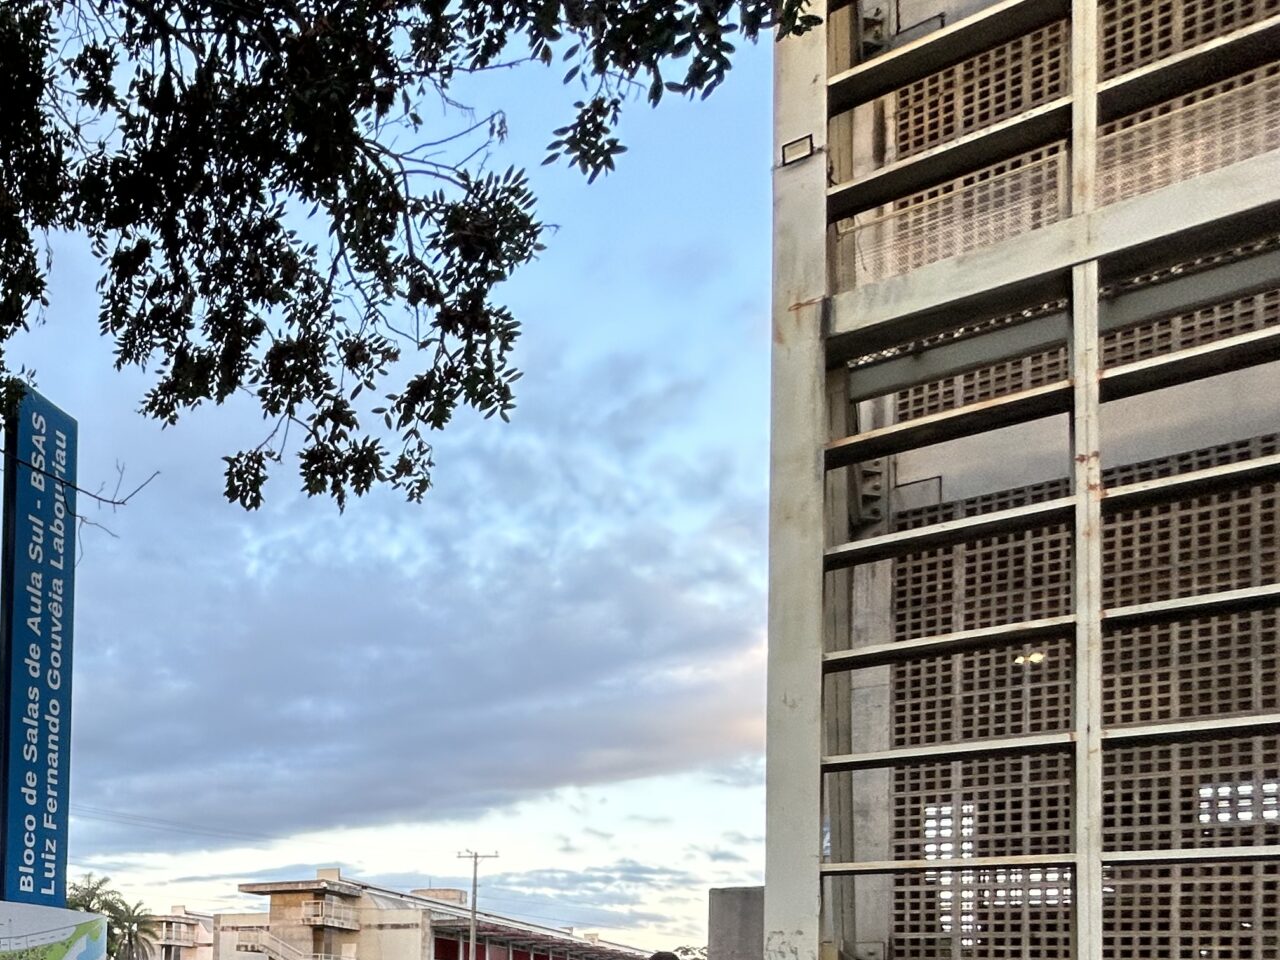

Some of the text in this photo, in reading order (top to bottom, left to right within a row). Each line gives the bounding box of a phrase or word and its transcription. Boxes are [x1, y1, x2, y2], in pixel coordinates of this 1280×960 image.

[31, 411, 47, 492] BSAS
[28, 517, 44, 564] Sul
[26, 572, 43, 637] Aula
[47, 579, 64, 691] Gouvêia
[25, 643, 40, 679] de
[23, 688, 39, 764] Salas
[21, 774, 37, 806] de
[44, 699, 61, 831] Fernando
[19, 814, 36, 893] Bloco
[41, 839, 56, 896] Luiz
